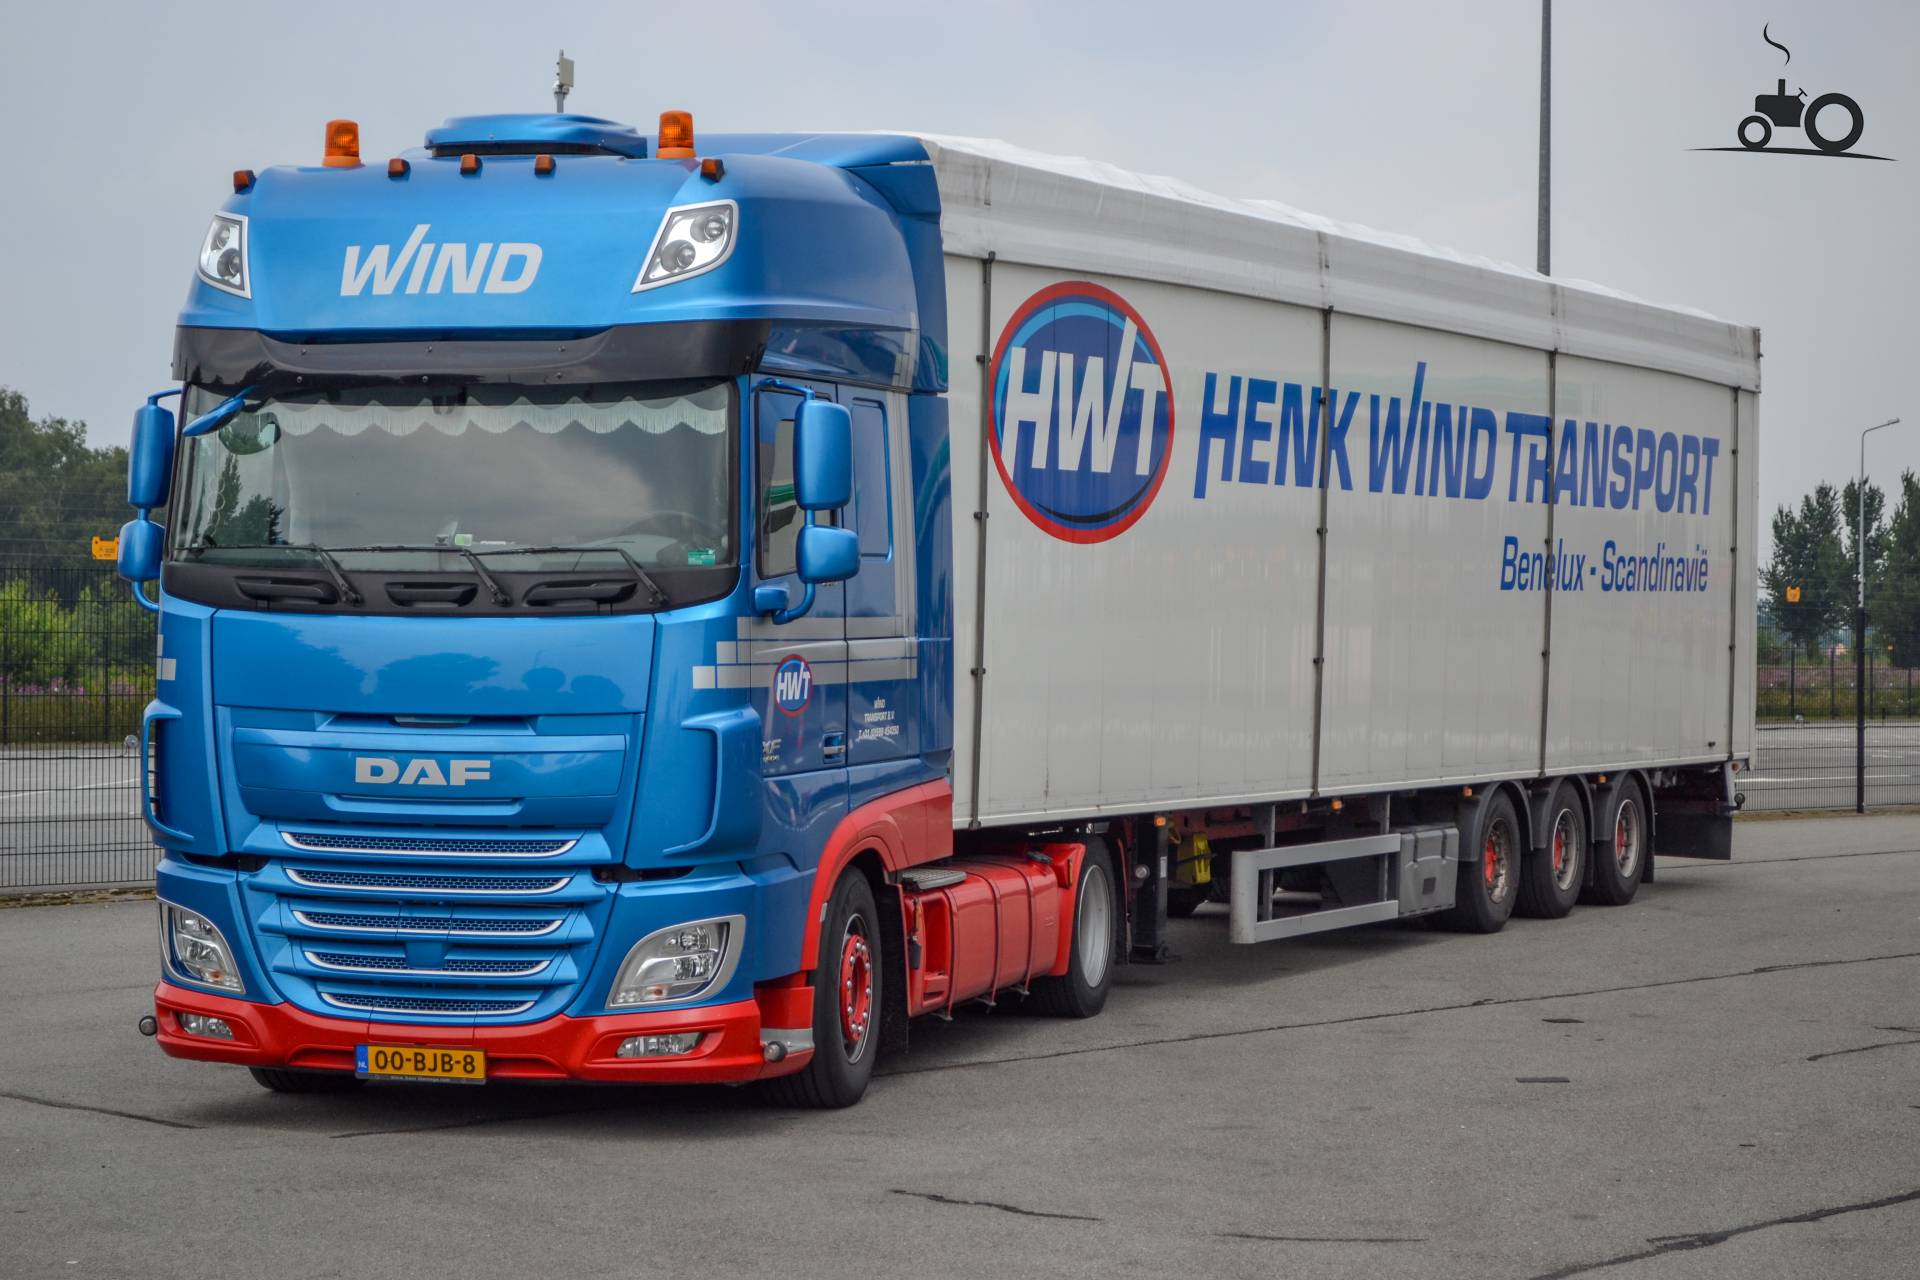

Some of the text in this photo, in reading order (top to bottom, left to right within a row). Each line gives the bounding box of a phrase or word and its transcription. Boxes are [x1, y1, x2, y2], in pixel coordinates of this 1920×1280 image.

[340, 223, 543, 296] WIND
[1001, 316, 1167, 482] HWT
[1193, 361, 1721, 516] HENK WIND TRANSPORT
[1500, 535, 1586, 592] Benelux
[1601, 540, 1709, 593] Scandinavië
[776, 661, 811, 704] HWT
[354, 757, 492, 786] DAF
[358, 1049, 476, 1075] NL 00-BJB-8
